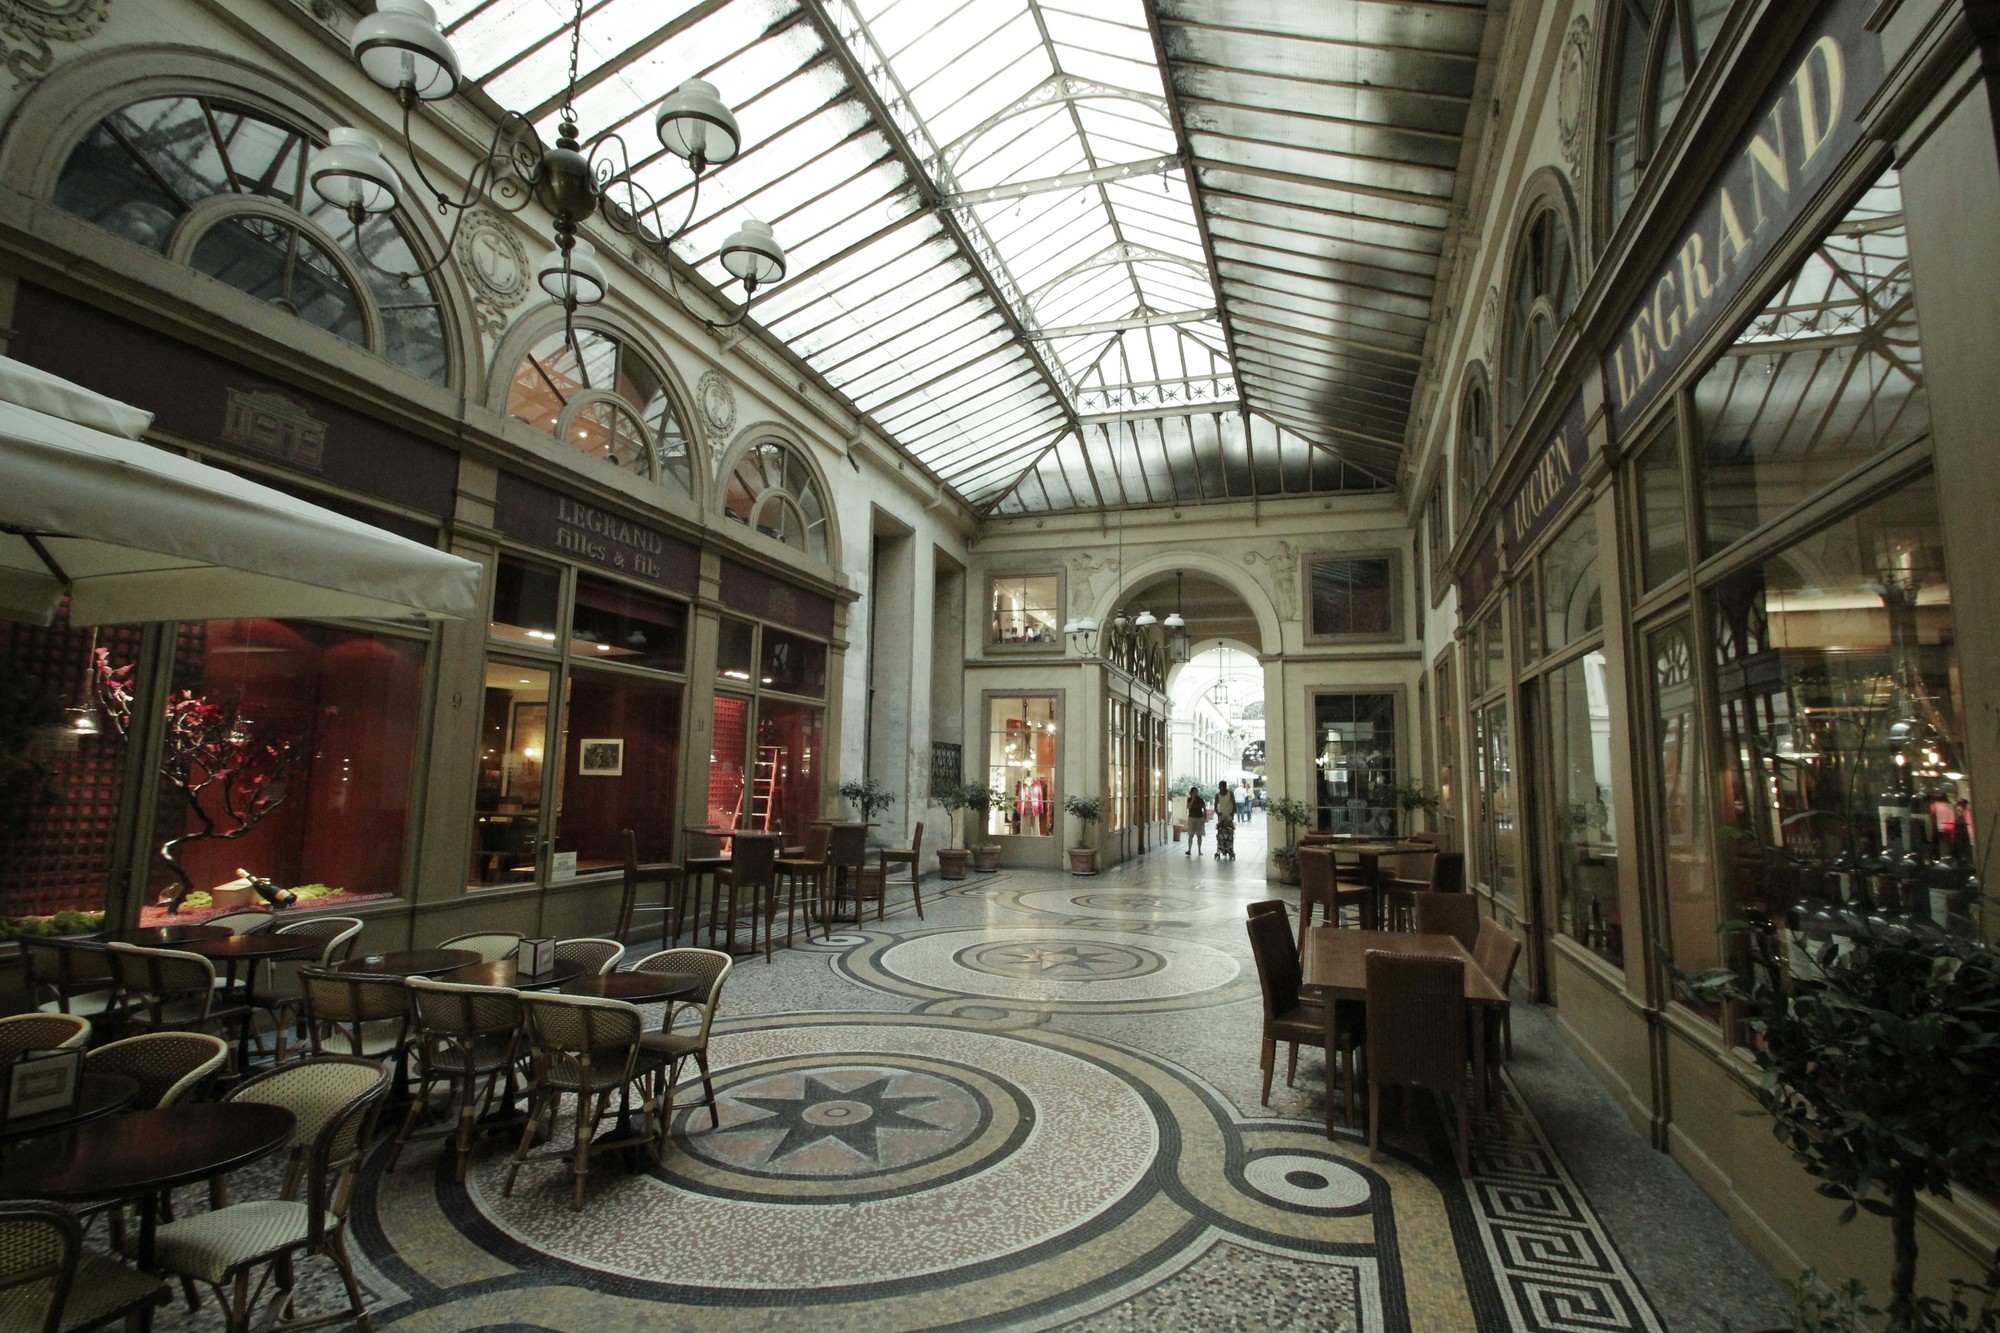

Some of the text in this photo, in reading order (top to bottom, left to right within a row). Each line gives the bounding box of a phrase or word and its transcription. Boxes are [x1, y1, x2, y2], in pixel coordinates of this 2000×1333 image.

[1513, 35, 1846, 541] LUCIEN LEGRAND
[556, 526, 661, 578] filles & fils
[557, 497, 662, 555] LEGRAND
[452, 690, 463, 710] 9
